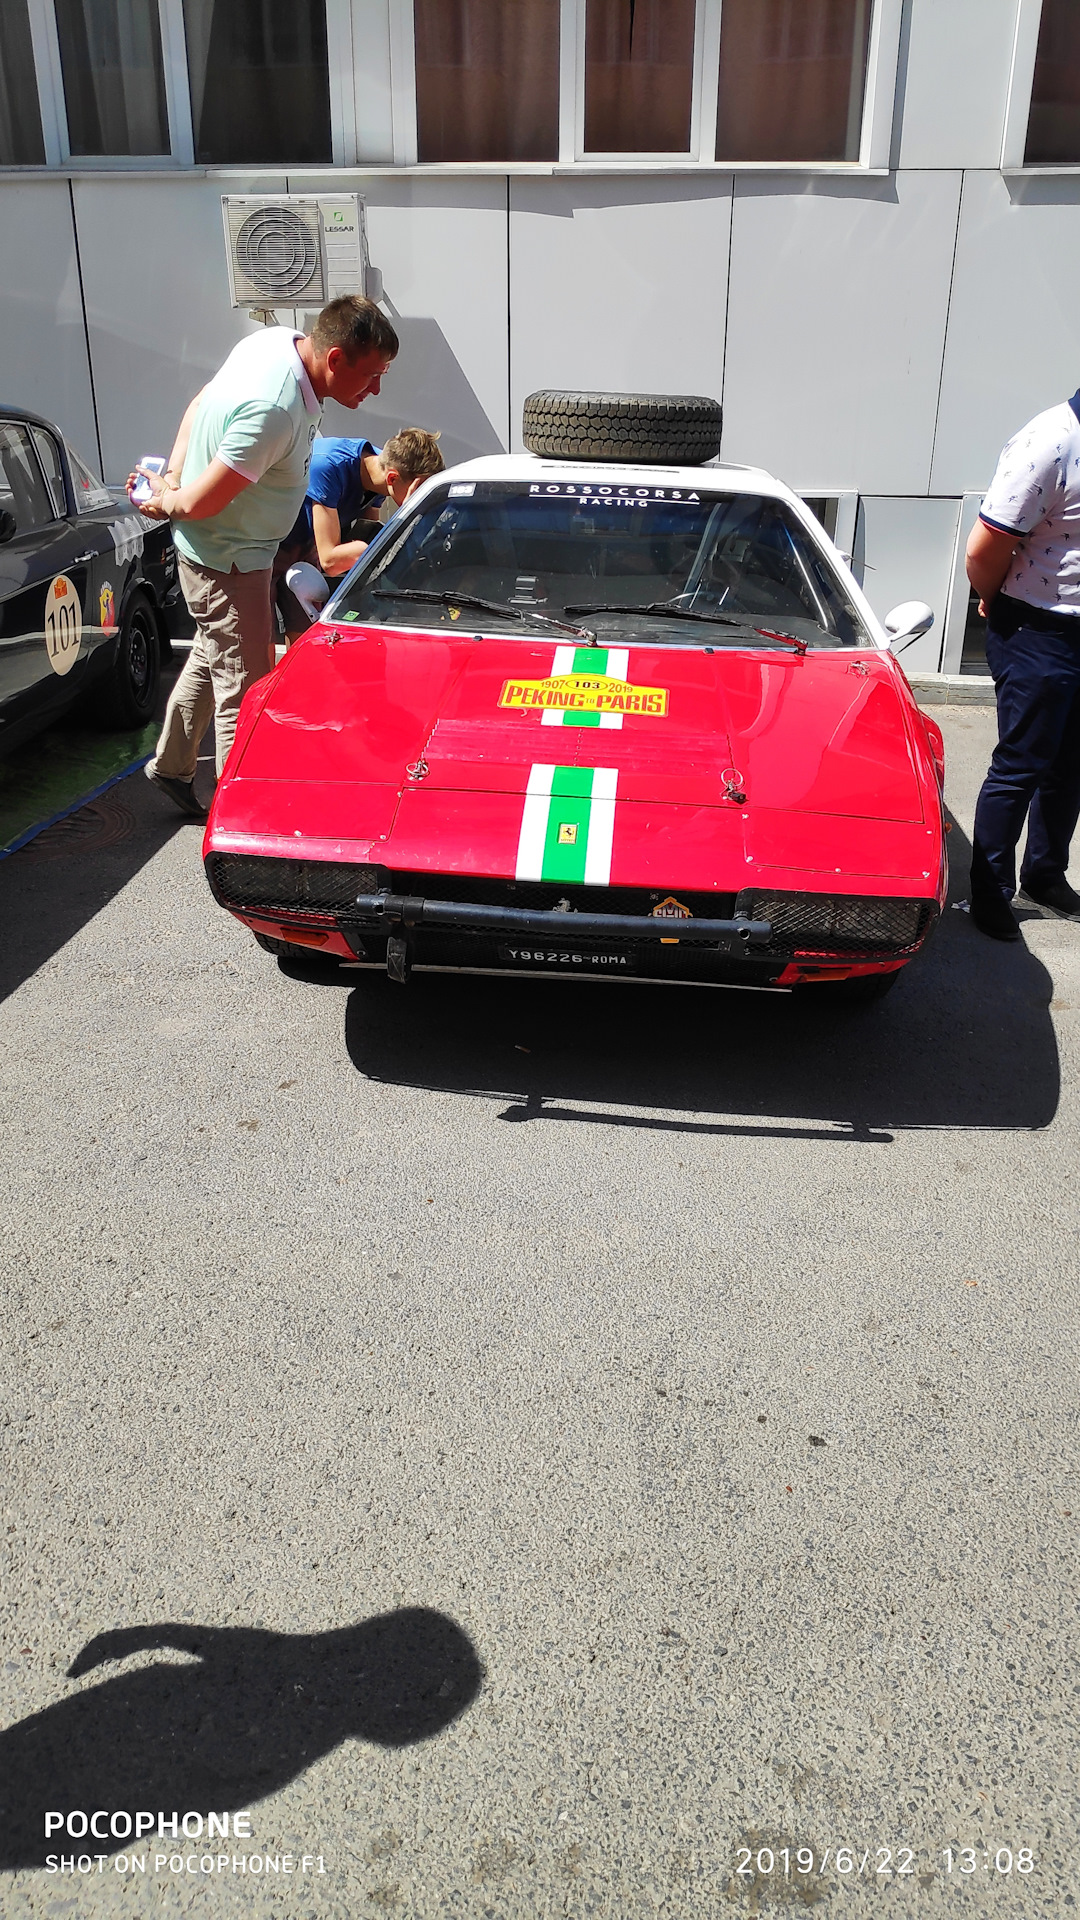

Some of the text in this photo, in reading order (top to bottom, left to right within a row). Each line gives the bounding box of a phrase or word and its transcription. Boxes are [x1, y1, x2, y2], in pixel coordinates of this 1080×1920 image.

[325, 225, 354, 233] LESSAR
[529, 484, 700, 500] ROSSOCORSA
[579, 498, 648, 507] RACING
[47, 601, 80, 658] 101
[541, 679, 633, 693] 1907 103 2019
[505, 685, 586, 707] PEKING
[596, 693, 663, 713] PARIS
